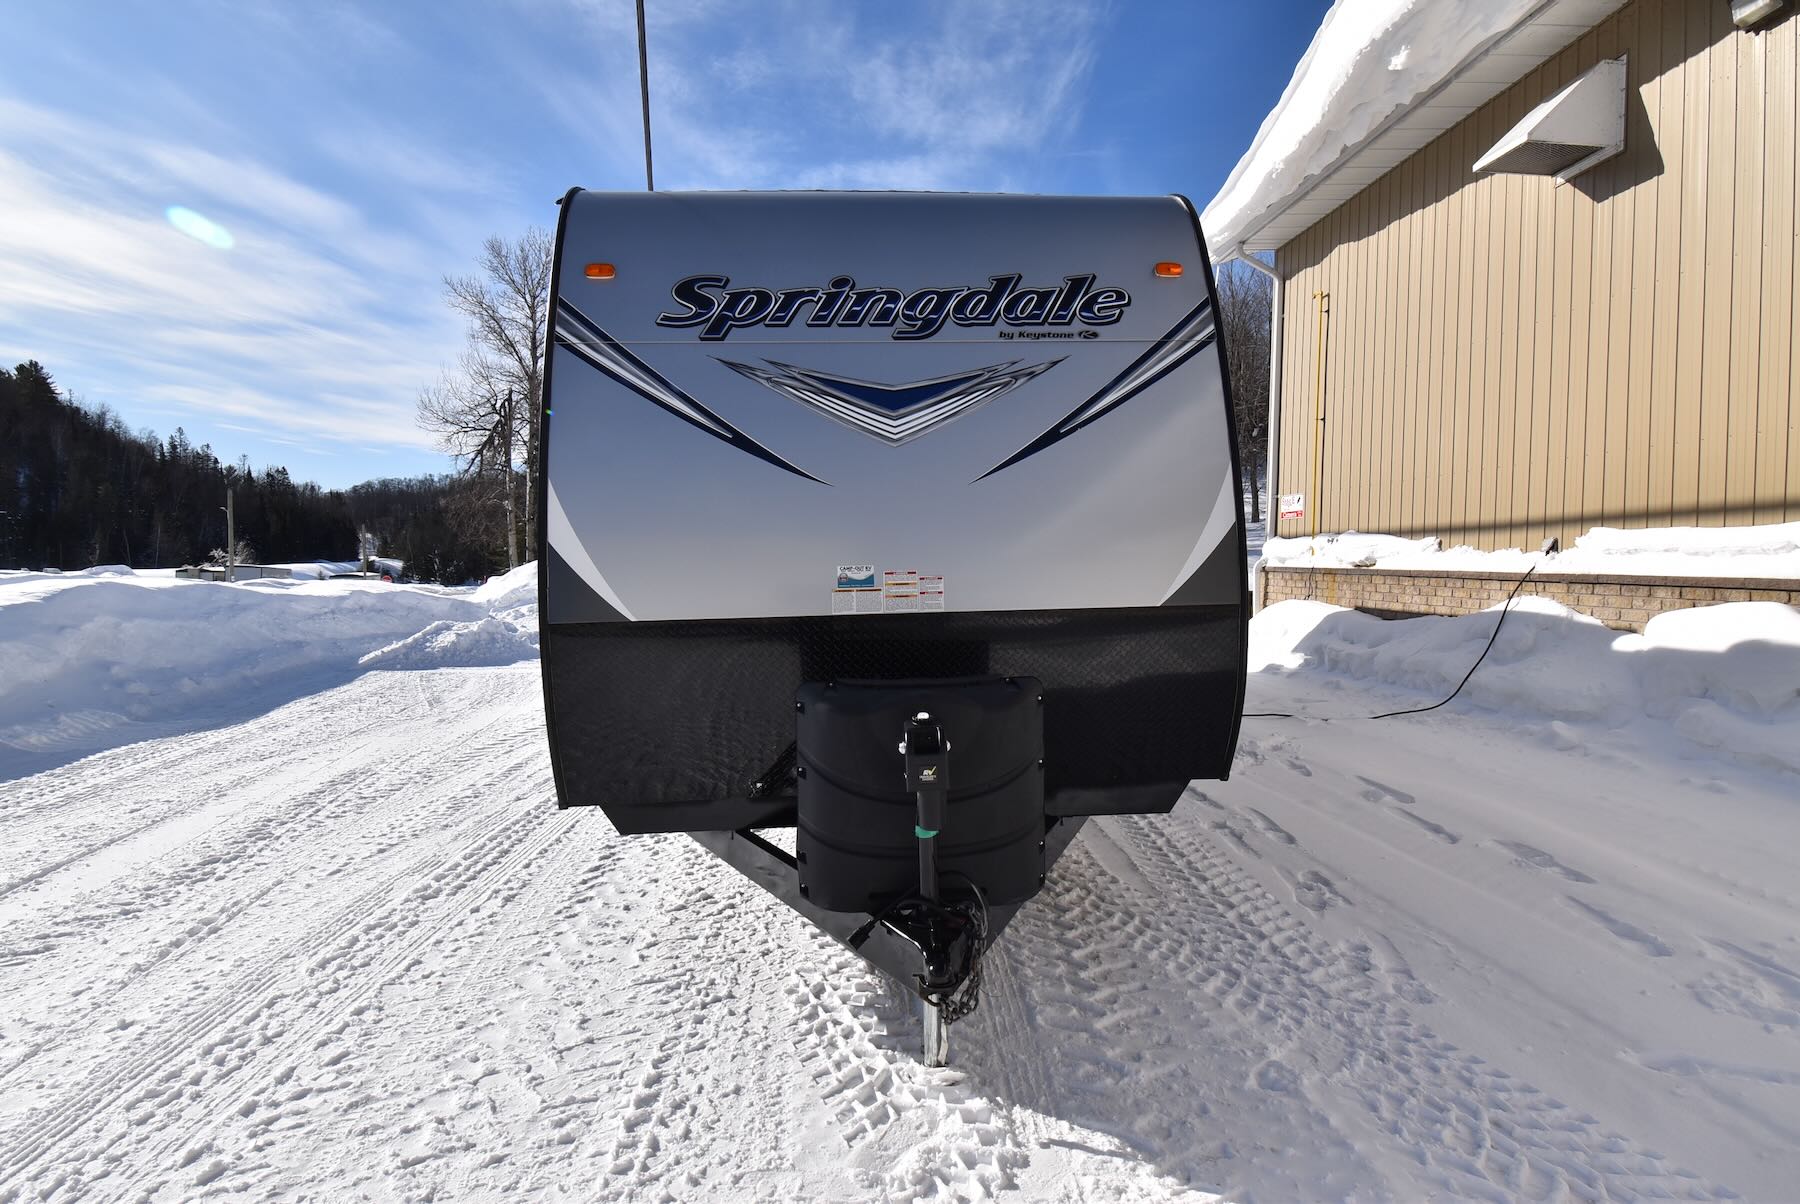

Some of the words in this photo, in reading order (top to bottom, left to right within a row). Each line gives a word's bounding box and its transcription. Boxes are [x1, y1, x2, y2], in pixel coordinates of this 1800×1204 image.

[656, 273, 1131, 341] Springdale
[999, 331, 1014, 340] by
[1018, 331, 1074, 340] Keystone
